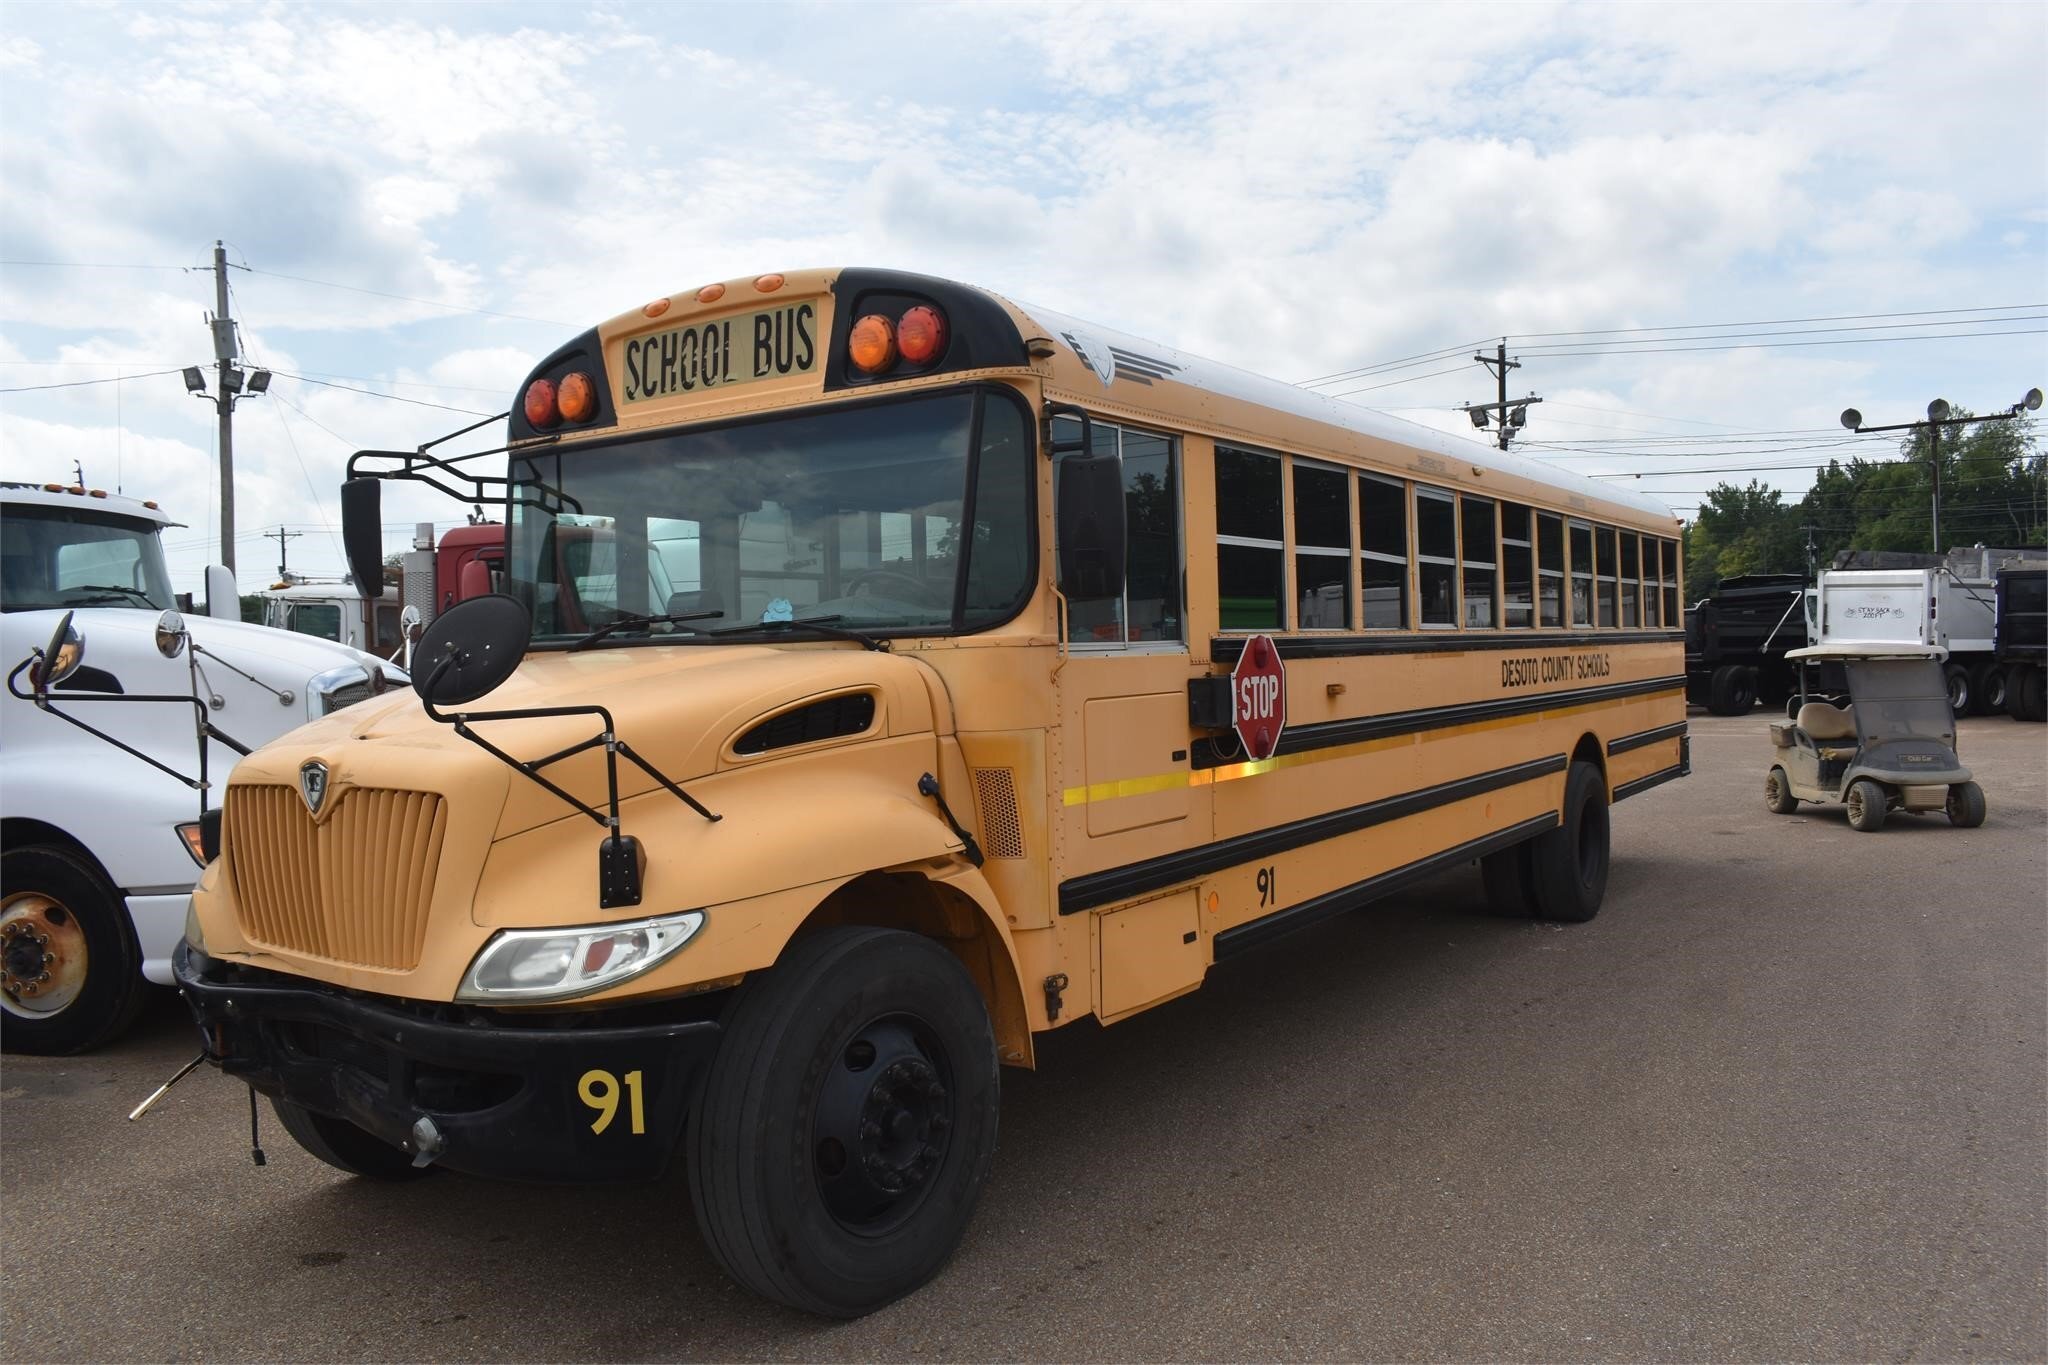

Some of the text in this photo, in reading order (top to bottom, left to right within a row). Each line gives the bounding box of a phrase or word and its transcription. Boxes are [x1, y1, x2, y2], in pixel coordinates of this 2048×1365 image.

[626, 304, 814, 400] SCHOOL BUS
[1502, 653, 1610, 688] DESOTO COUNTY SCHOOLS
[1241, 674, 1279, 721] STOP
[1256, 866, 1275, 909] 91
[578, 1069, 645, 1136] 91
